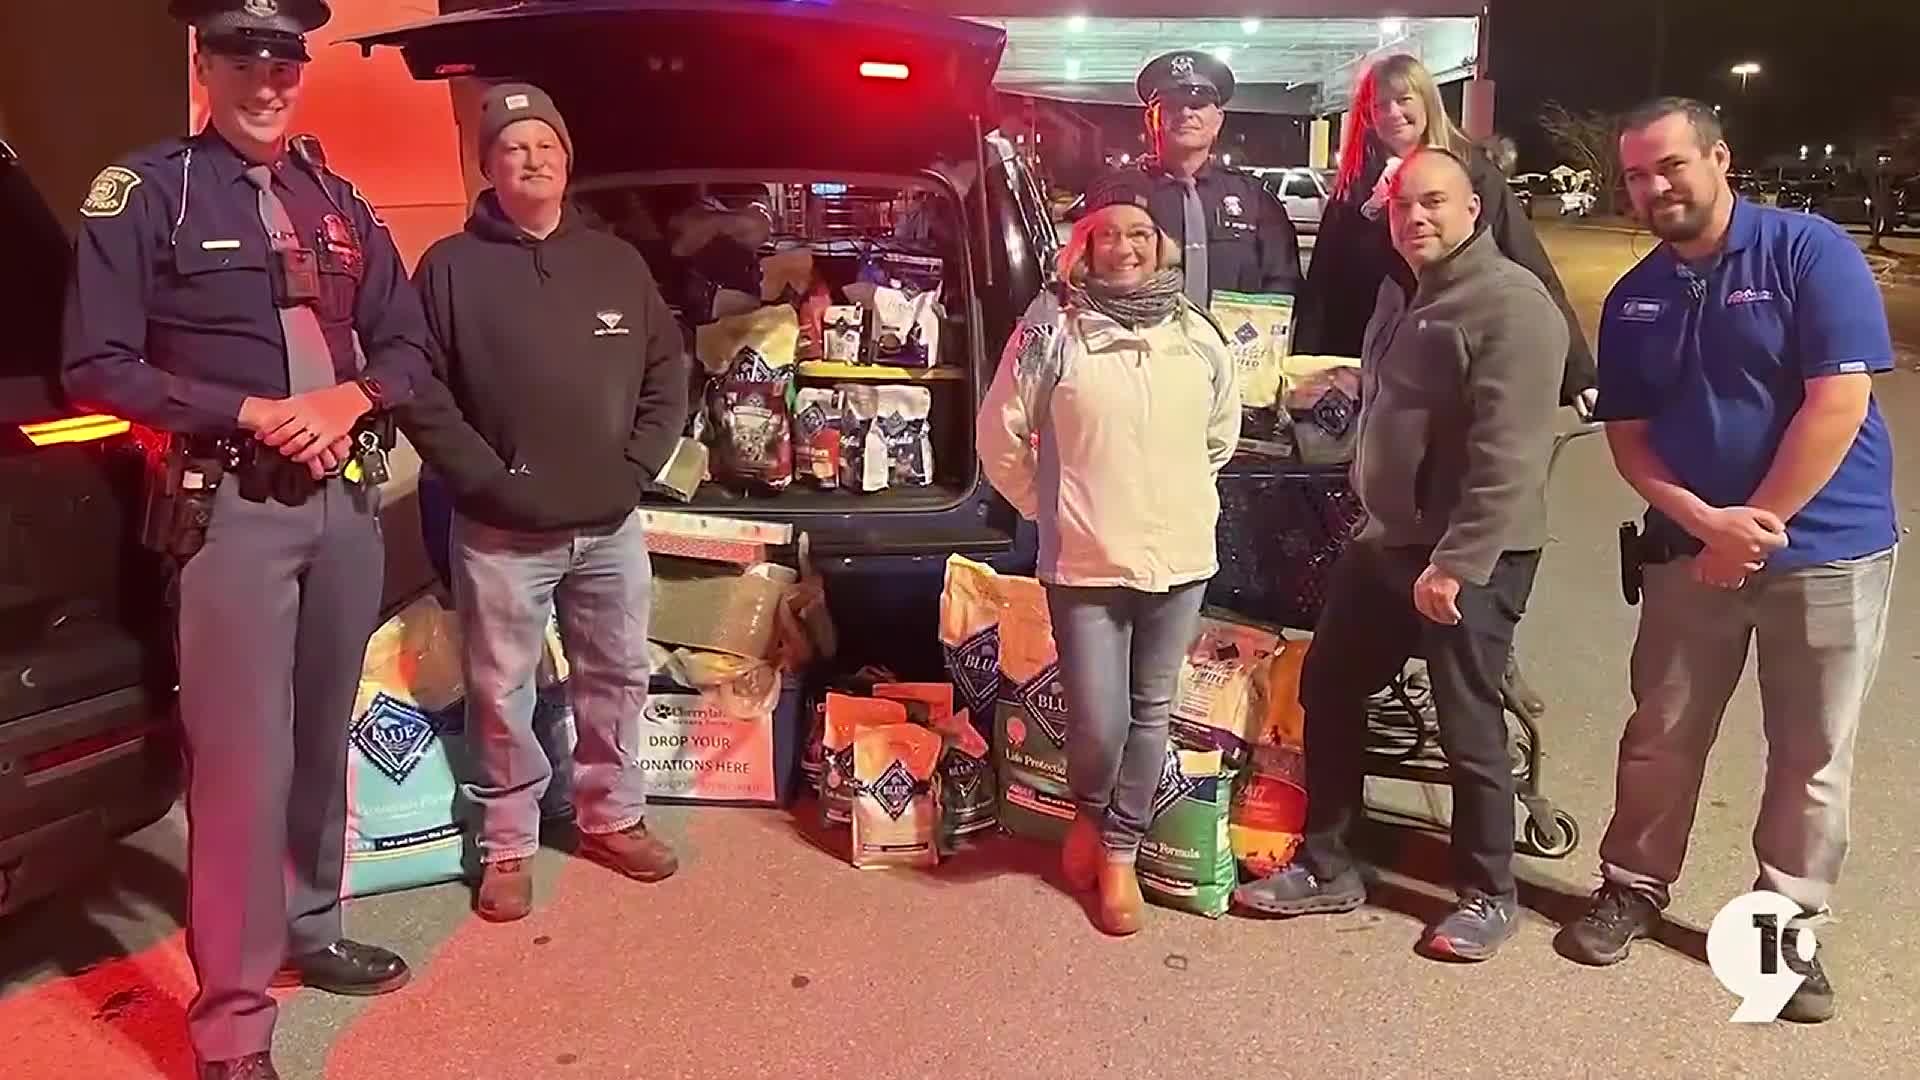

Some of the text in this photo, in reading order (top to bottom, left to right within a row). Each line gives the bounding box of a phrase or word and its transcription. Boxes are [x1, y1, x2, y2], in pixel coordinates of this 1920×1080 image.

[1038, 694, 1068, 713] BLU
[672, 706, 728, 719] Cherryla
[649, 735, 731, 749] DROP YOUR
[716, 760, 750, 774] HERE
[1024, 755, 1067, 776] Protectio
